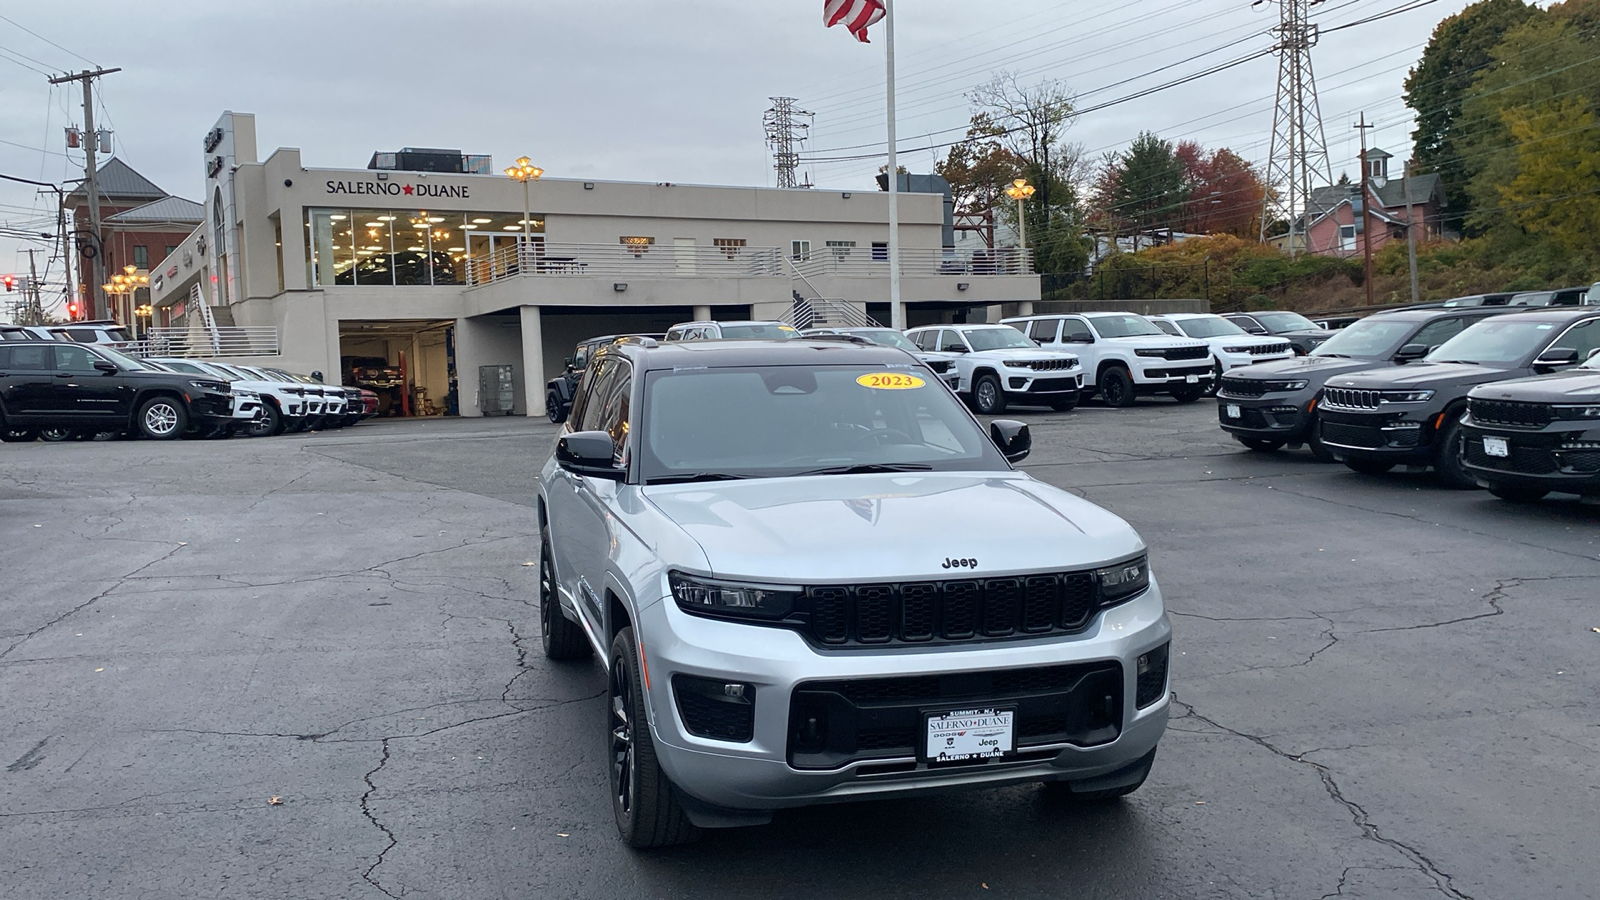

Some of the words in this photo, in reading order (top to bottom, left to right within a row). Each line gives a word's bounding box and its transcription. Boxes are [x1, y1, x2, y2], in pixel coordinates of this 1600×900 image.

[326, 180, 401, 196] SALERNO
[416, 183, 470, 199] DUANE
[870, 375, 913, 387] 2023
[941, 557, 978, 570] Jeep
[930, 719, 973, 731] SALERNO
[977, 717, 1010, 726] DUANE
[978, 738, 999, 747] Jeep
[936, 754, 970, 762] SALERNO
